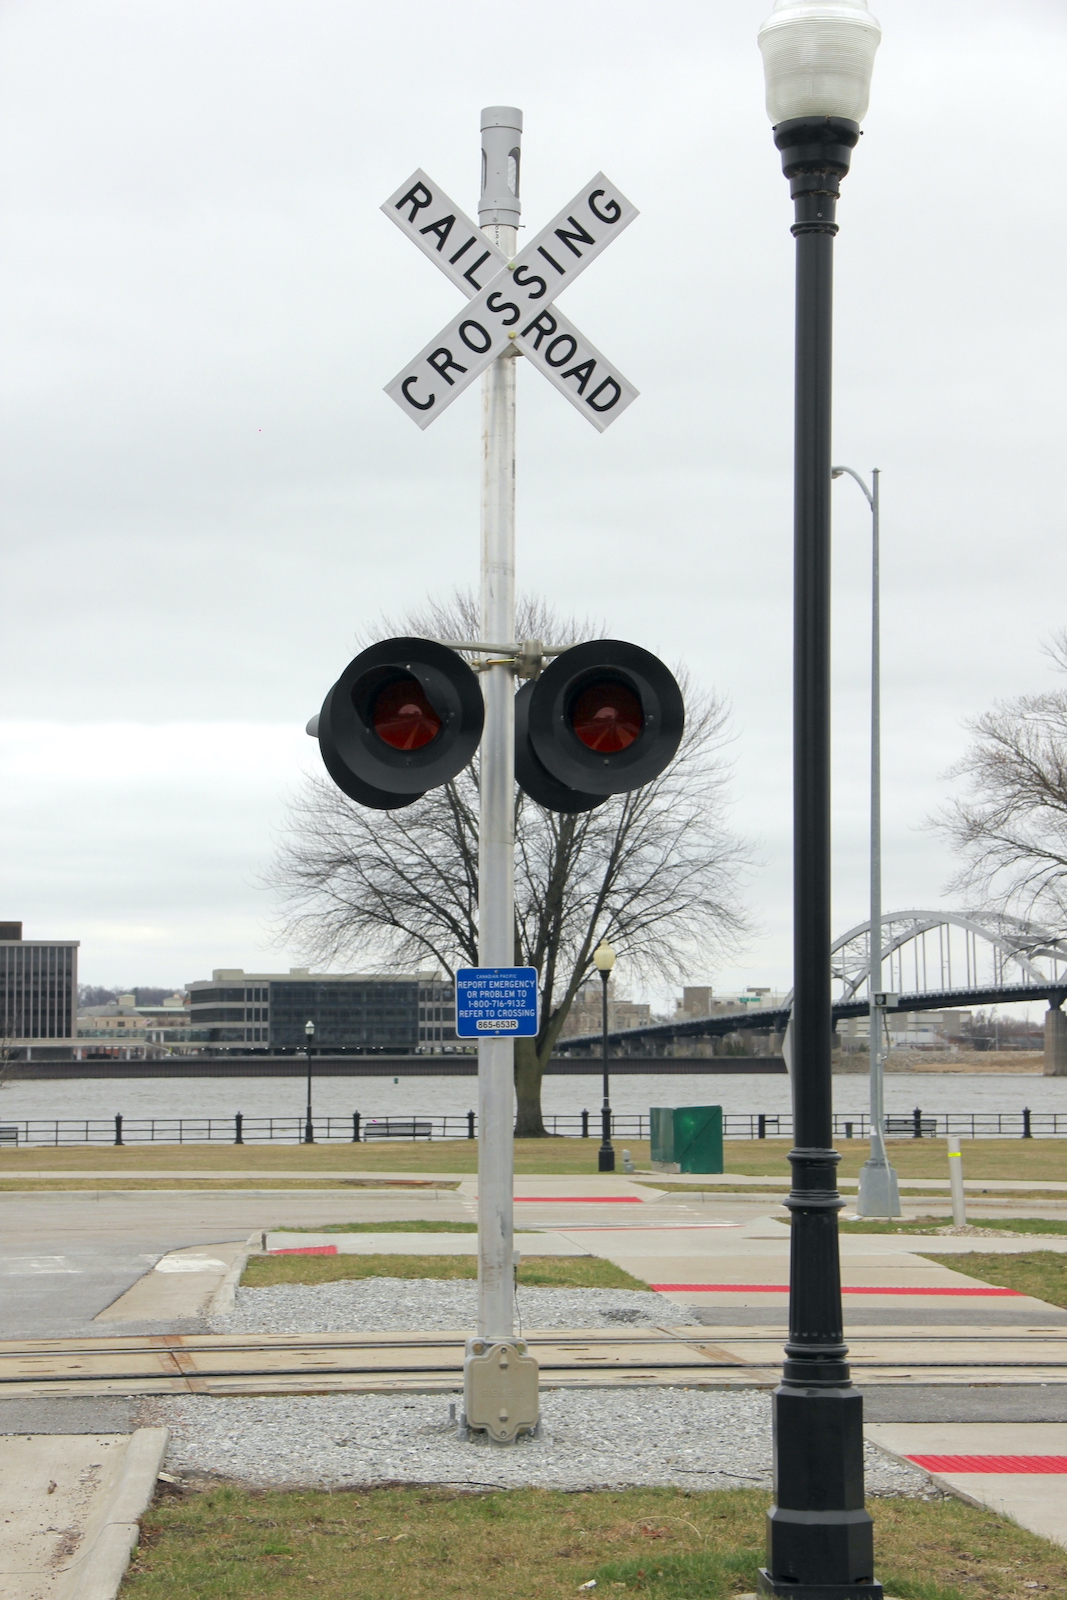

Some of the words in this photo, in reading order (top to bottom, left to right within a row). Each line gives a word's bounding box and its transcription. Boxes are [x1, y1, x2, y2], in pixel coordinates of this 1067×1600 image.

[395, 181, 491, 291] RAIL
[520, 309, 622, 412] ROAD
[401, 189, 622, 411] CROSSING
[458, 981, 487, 989] REPORT
[489, 980, 535, 988] EMERGENCY
[479, 990, 515, 998] PROBLEM
[468, 1000, 526, 1008] 1-800-716-9132
[485, 1009, 495, 1017] TO
[497, 1009, 535, 1017] CROSSING
